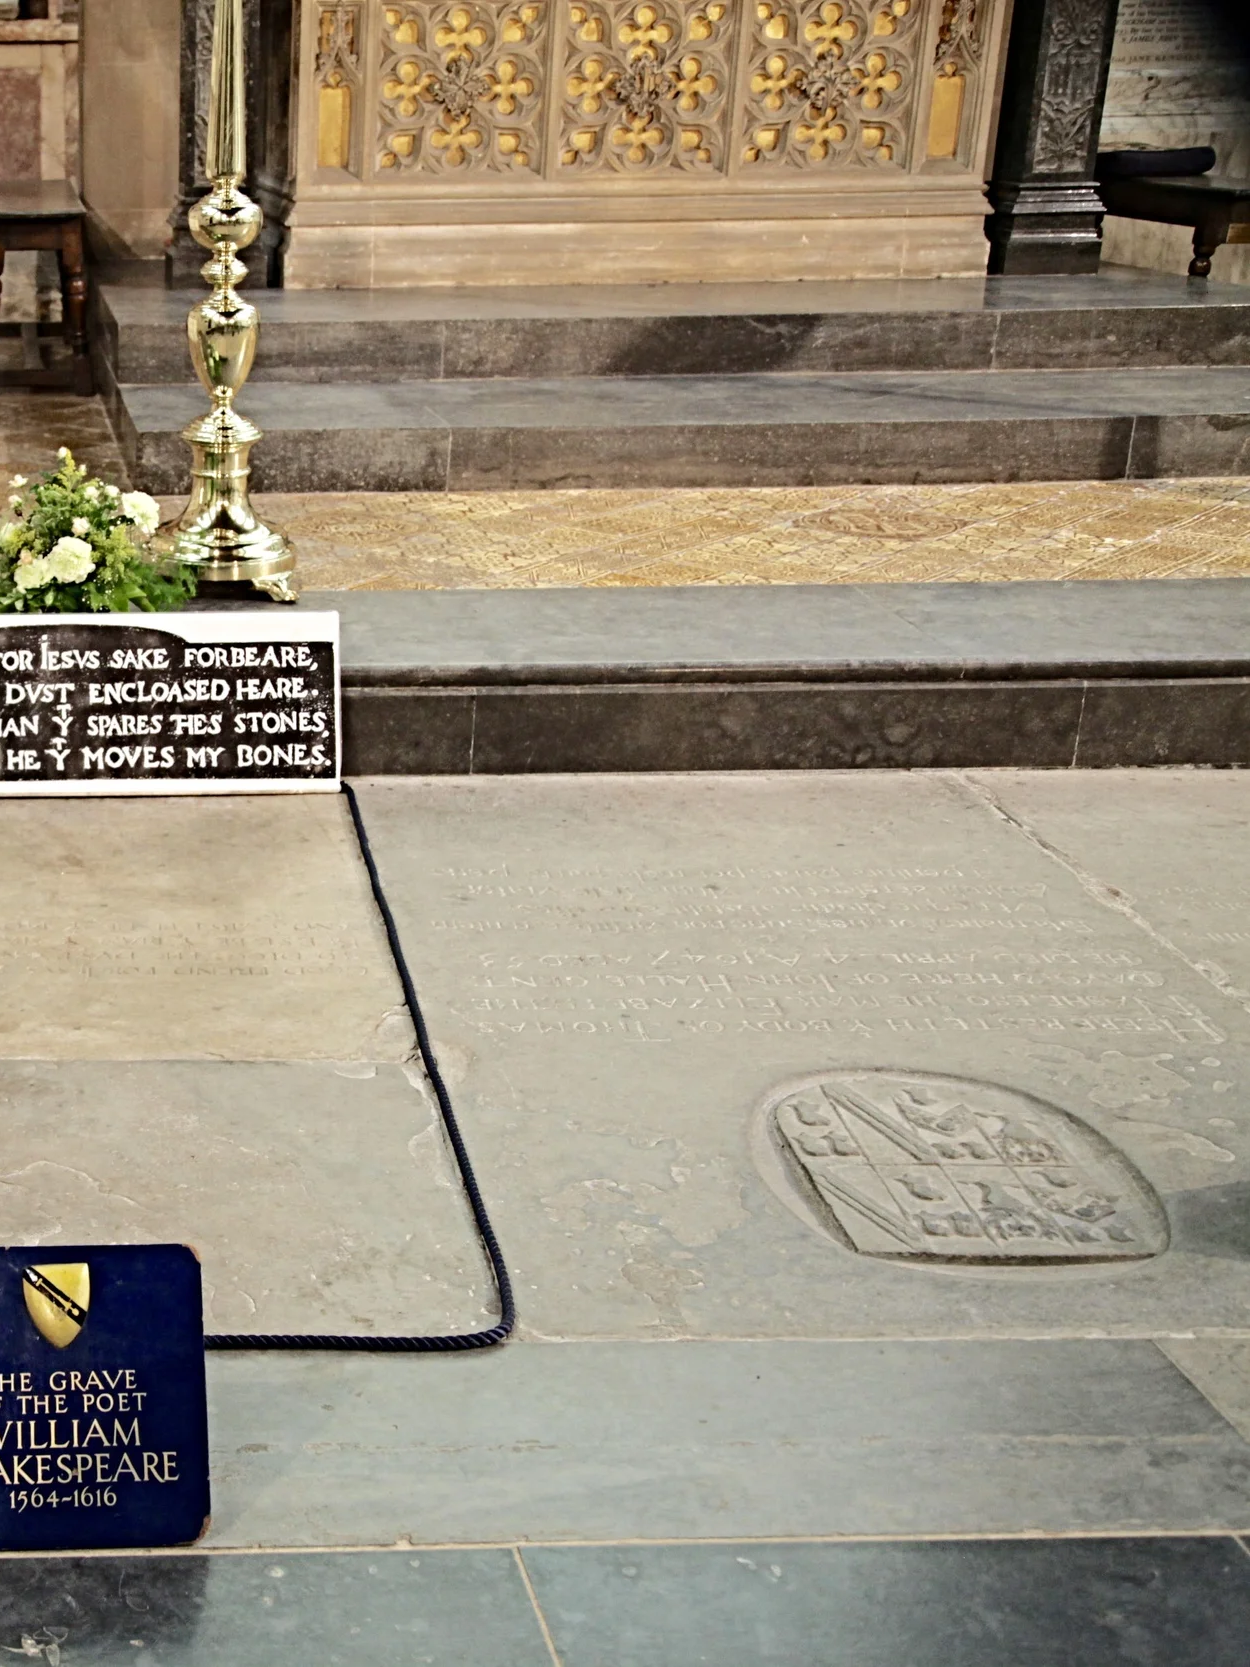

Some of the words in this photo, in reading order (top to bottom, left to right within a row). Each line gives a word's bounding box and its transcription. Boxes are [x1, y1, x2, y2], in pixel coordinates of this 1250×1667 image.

[108, 648, 172, 669] SAKE
[183, 646, 319, 671] FORBEARE,
[5, 683, 76, 705] DVST
[88, 678, 231, 705] ENCLOASED
[86, 714, 164, 737] SPARES
[234, 711, 330, 738] STONES,
[6, 749, 41, 771] HE
[82, 745, 175, 770] MOVES
[185, 746, 225, 769] MY
[237, 744, 332, 769] BONES.
[49, 1370, 137, 1392] GRAVE
[17, 1394, 68, 1414] THE
[83, 1392, 147, 1413] POET
